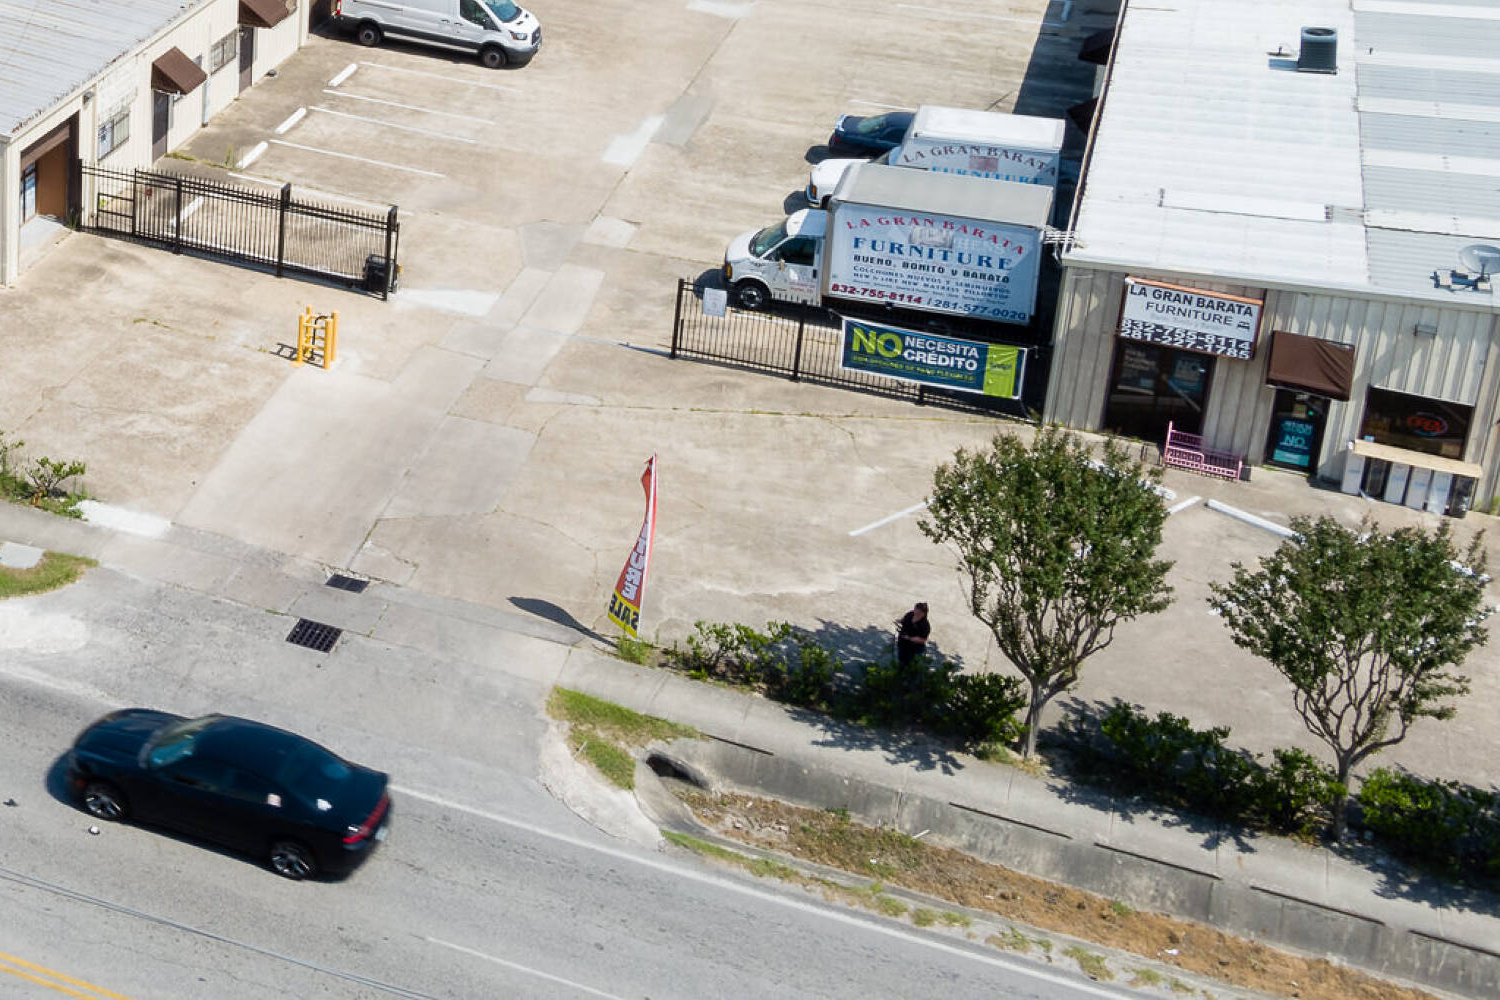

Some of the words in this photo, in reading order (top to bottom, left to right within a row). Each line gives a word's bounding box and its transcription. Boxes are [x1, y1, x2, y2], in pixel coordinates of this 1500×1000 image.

[903, 150, 925, 163] LA
[930, 145, 981, 157] GRAN
[987, 146, 1056, 176] BARATA
[846, 218, 871, 230] LA
[877, 216, 934, 227] GRAN
[942, 220, 1024, 255] BARATA
[852, 236, 1014, 271] FURNITURE
[901, 260, 946, 275] BONITO
[963, 270, 1010, 285] BARATO
[831, 282, 922, 305] 832-755-8114
[934, 298, 1027, 321] 281-577-0020
[1129, 284, 1148, 298] LA
[1152, 287, 1193, 306] GRAN
[1196, 296, 1253, 317] BARATA
[1146, 301, 1233, 326] FURNITURE
[852, 327, 903, 358] NO
[904, 335, 980, 359] NECESITA
[1120, 328, 1250, 360] 281-227-1785
[1121, 318, 1251, 350] 832-755-8114
[903, 347, 978, 371] CRÉDITO
[1406, 414, 1444, 433] OPEN
